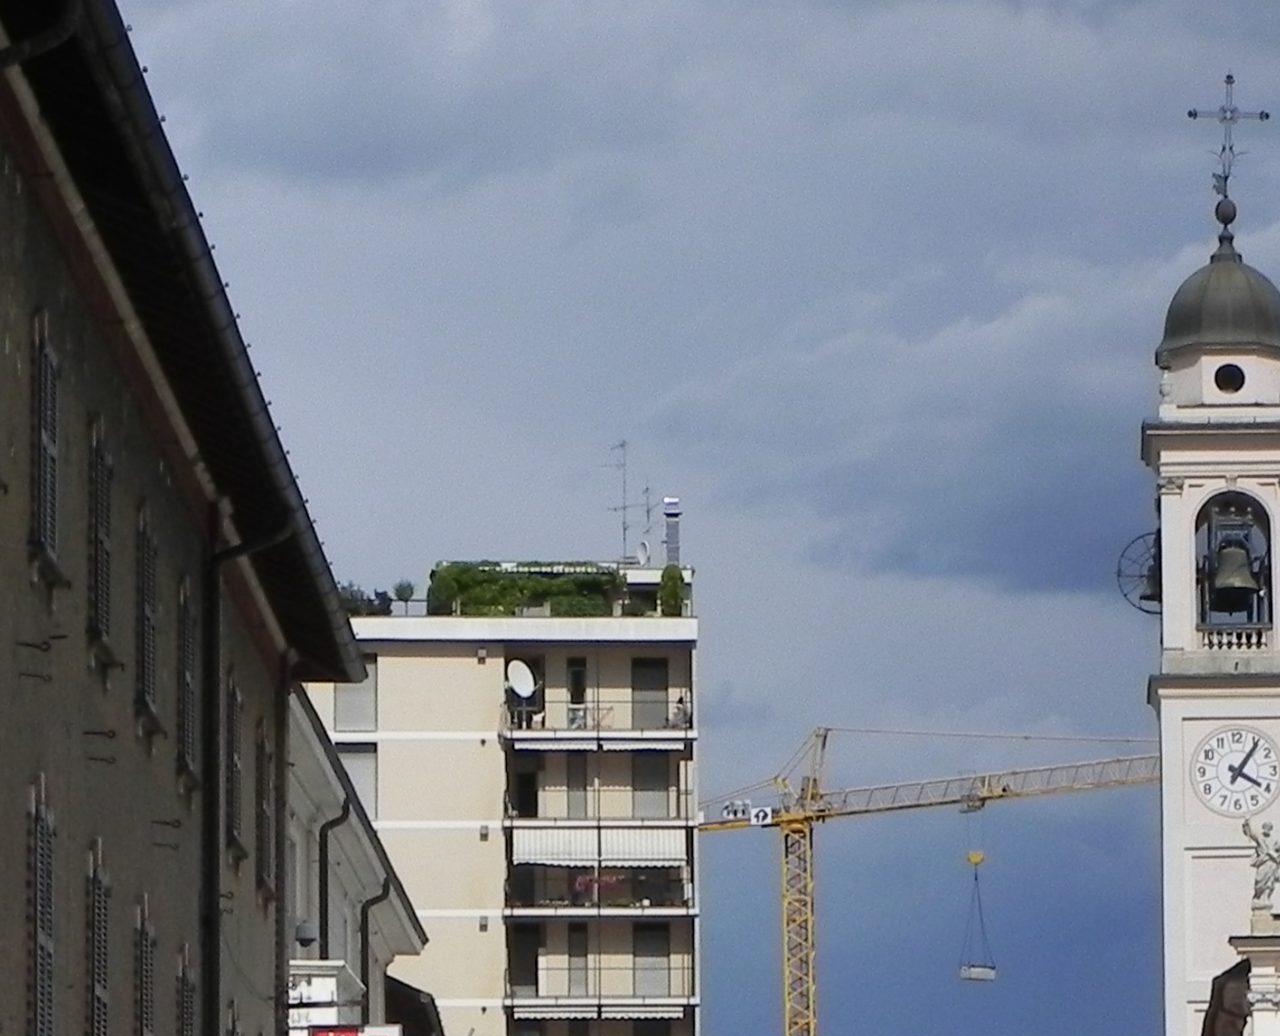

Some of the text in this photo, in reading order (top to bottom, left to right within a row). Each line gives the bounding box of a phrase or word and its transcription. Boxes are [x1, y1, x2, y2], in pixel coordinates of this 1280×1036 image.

[1217, 738, 1224, 749] 11
[1231, 732, 1243, 744] 12
[1203, 749, 1214, 760] 10
[1263, 747, 1272, 758] 2
[1198, 766, 1206, 778] 9
[1269, 766, 1277, 777] 3
[1203, 784, 1211, 795] 8
[1264, 783, 1271, 794] 4
[1219, 795, 1228, 807] 7
[1234, 799, 1242, 810] 6
[1250, 795, 1259, 806] 5
